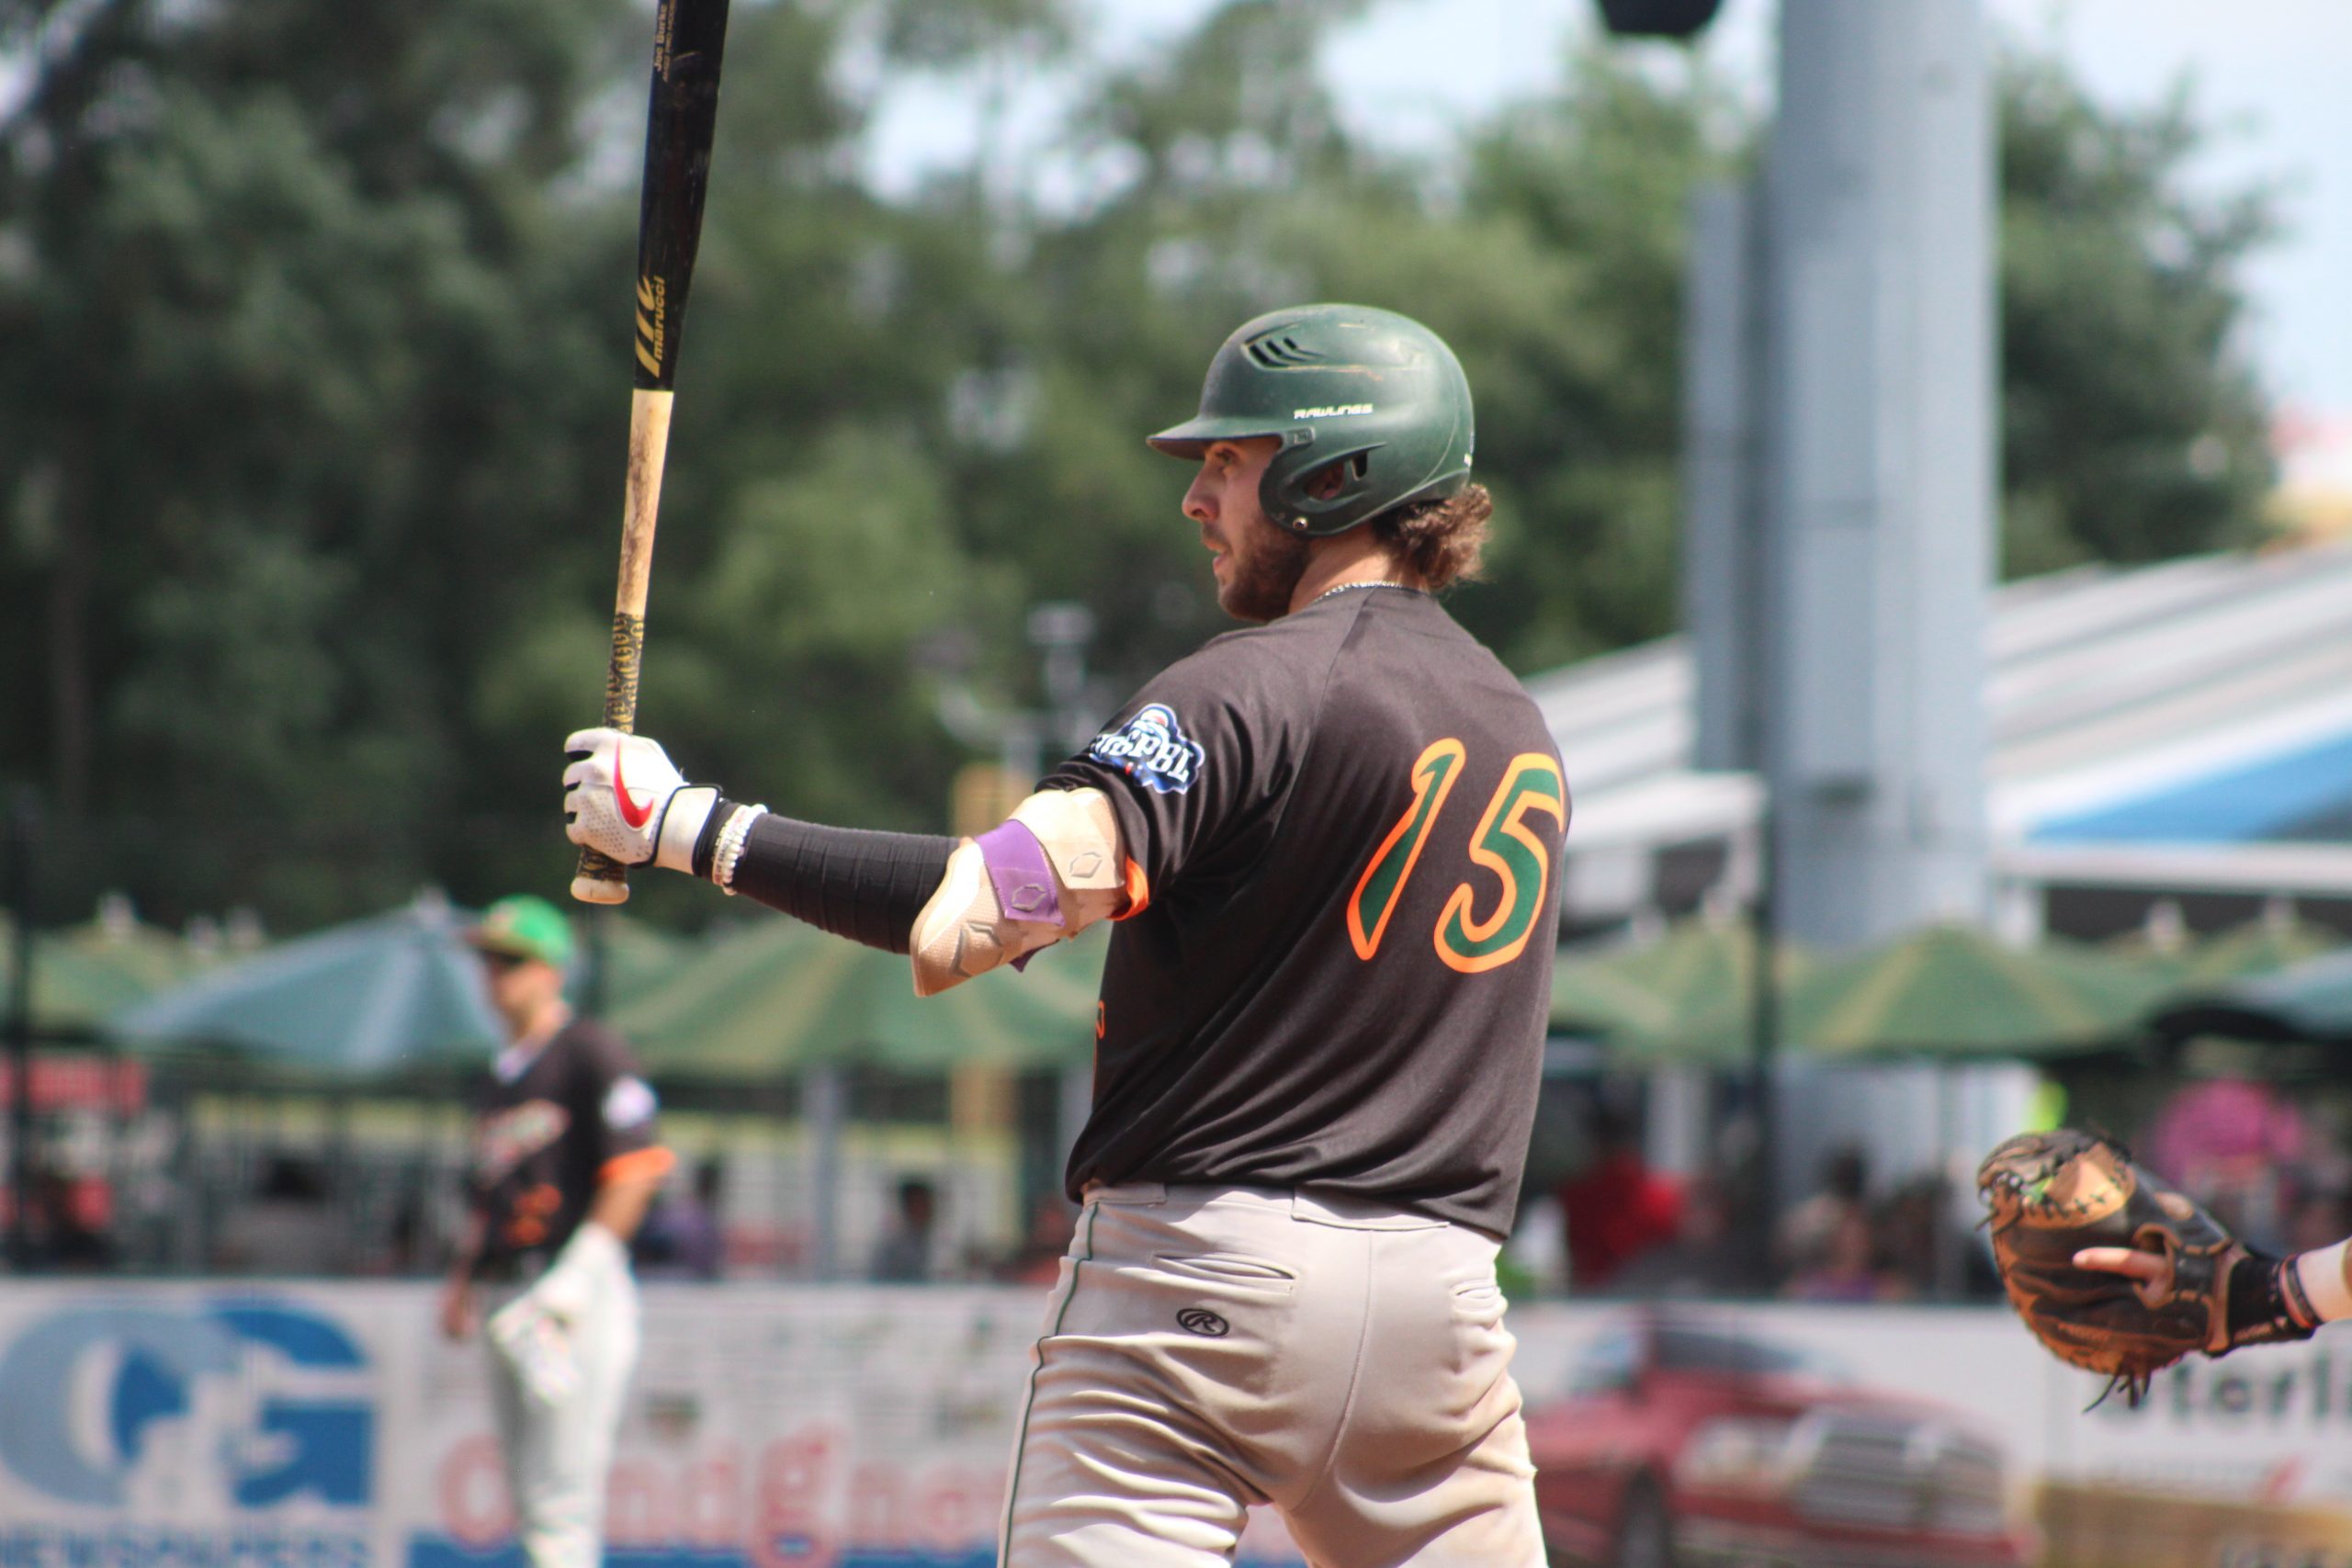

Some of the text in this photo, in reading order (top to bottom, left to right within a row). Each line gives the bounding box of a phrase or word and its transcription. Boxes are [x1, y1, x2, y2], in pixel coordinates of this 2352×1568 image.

[653, 276, 664, 361] marucci
[1294, 403, 1373, 419] RAWLINGS
[1346, 738, 1565, 974] 15
